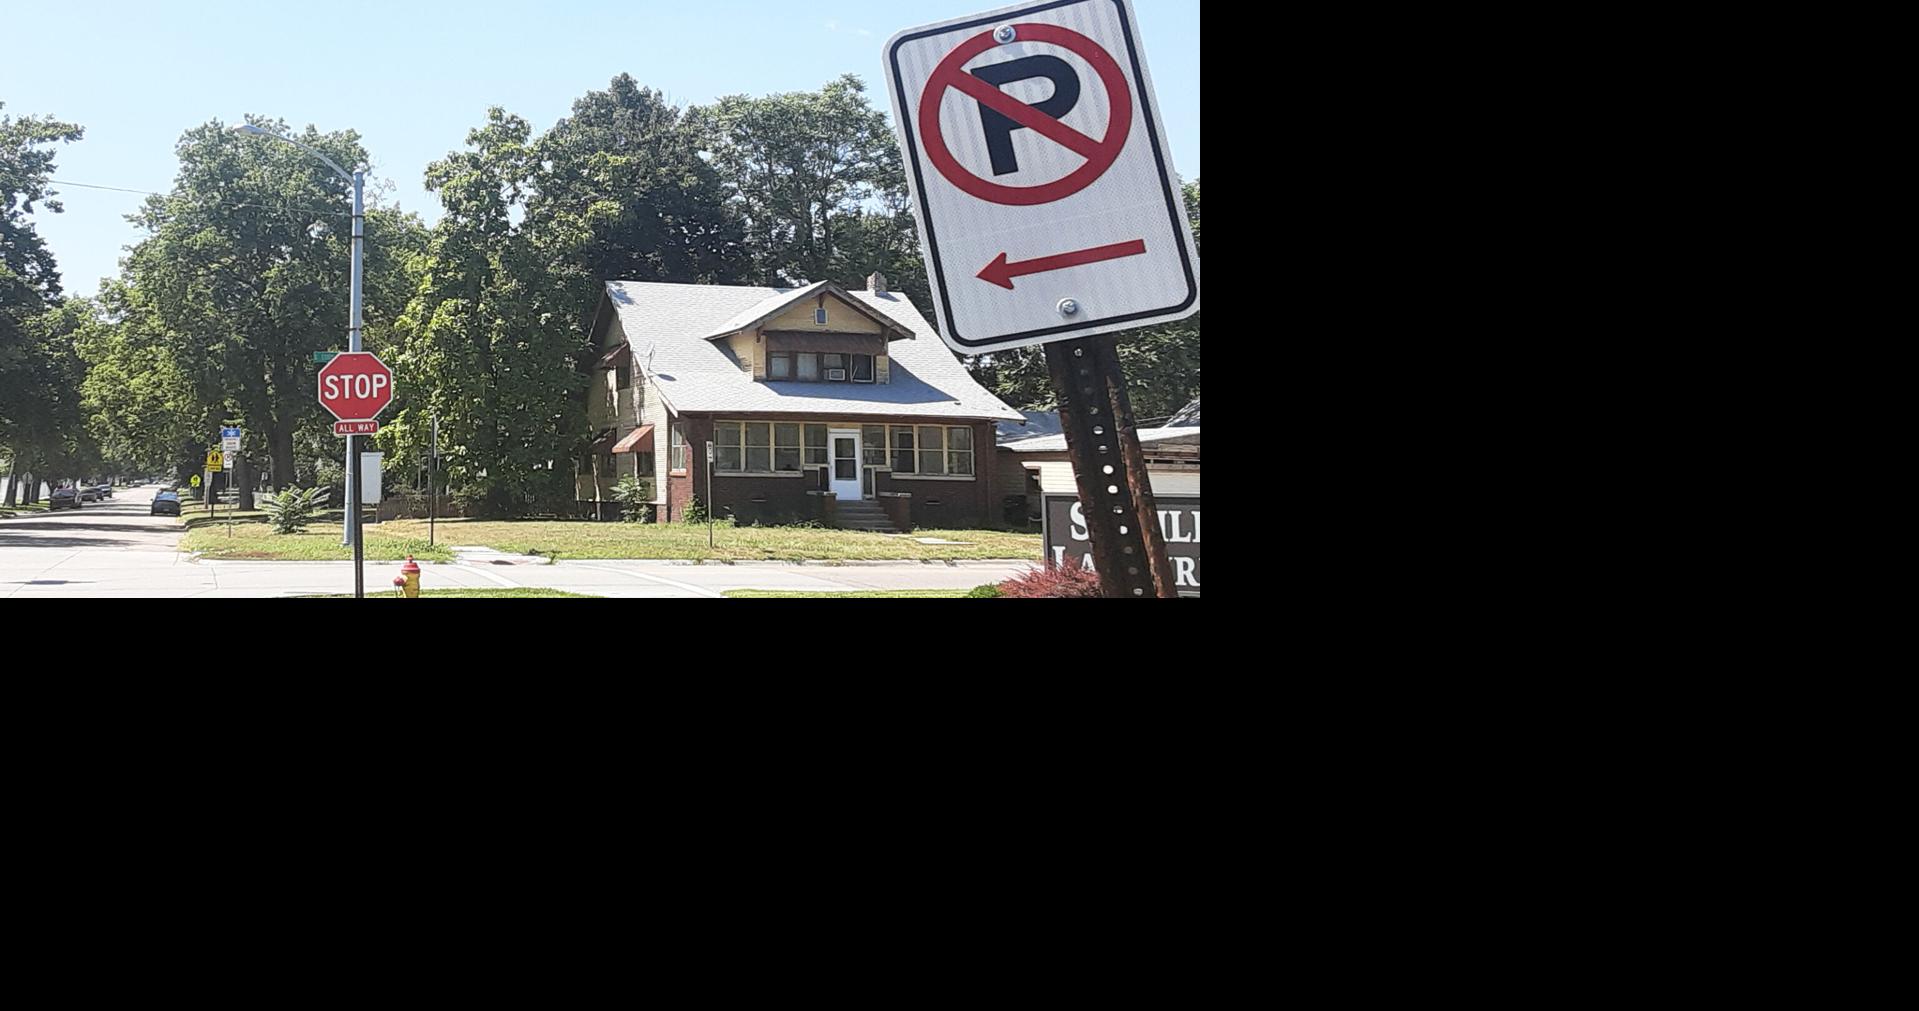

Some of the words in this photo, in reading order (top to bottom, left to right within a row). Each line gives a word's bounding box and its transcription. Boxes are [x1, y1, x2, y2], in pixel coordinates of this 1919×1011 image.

[970, 54, 1081, 177] P
[323, 373, 387, 400] STOP
[338, 424, 353, 432] ALL
[357, 423, 375, 432] WAY
